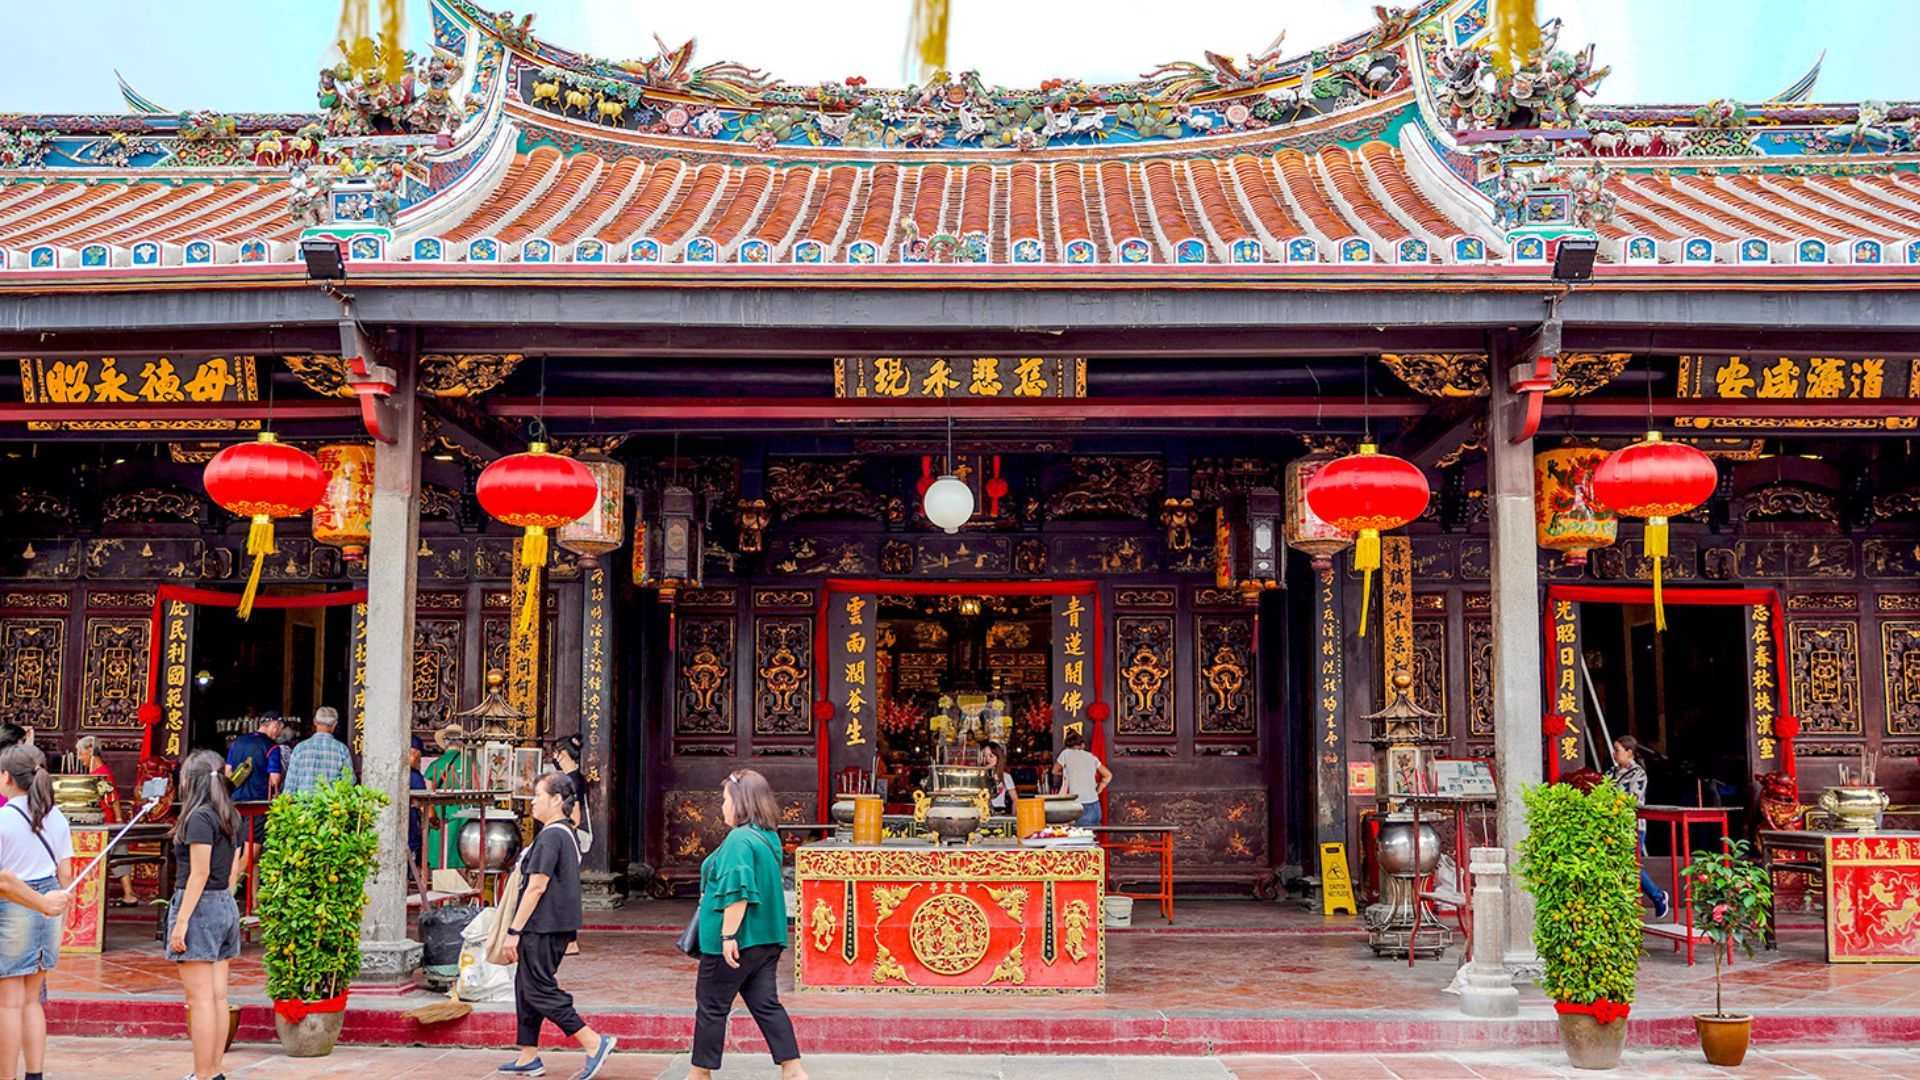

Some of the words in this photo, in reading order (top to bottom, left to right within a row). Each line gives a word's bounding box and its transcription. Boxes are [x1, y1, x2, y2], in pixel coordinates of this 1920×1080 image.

[845, 596, 867, 746] 雲雨潤蒼生
